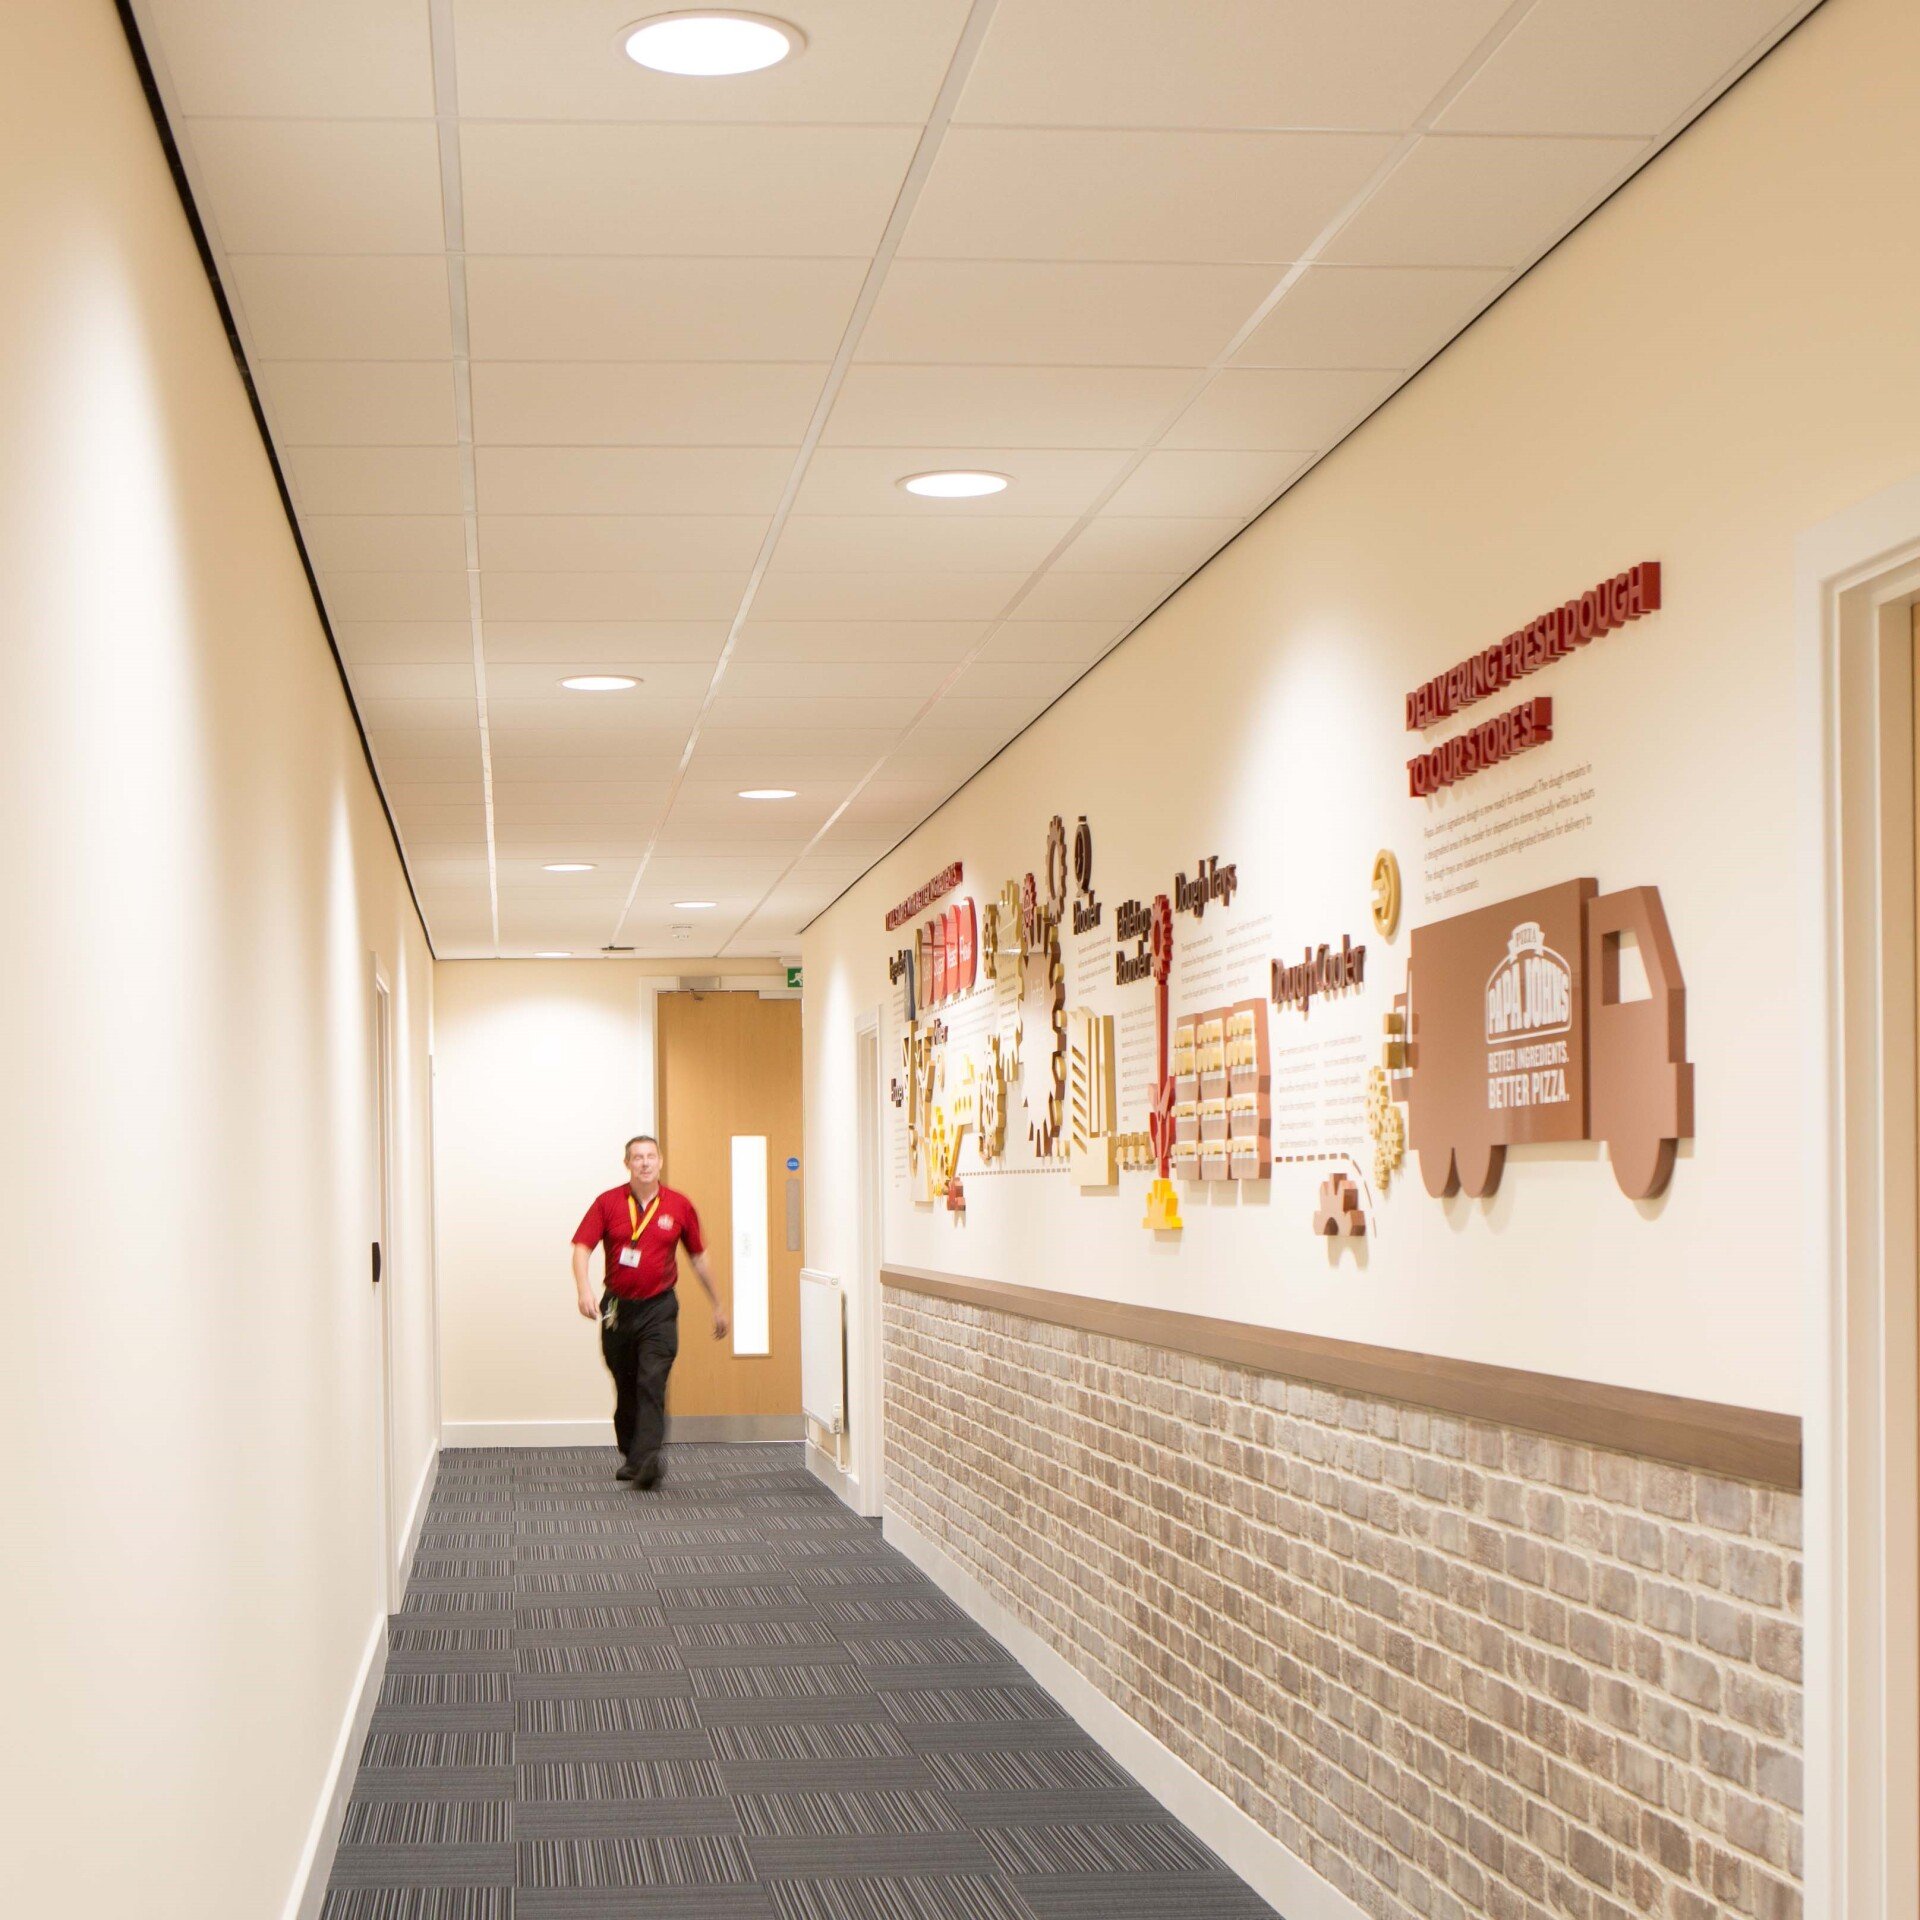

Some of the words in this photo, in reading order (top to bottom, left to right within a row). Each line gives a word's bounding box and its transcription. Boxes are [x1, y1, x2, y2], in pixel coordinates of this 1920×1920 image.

[1406, 645, 1502, 731] DELIVERING
[1501, 606, 1566, 687] FRESH
[1564, 562, 1661, 652] DOUGH
[1406, 754, 1431, 797] TO
[1428, 735, 1467, 793] OUR
[1175, 860, 1209, 918] Dough
[1207, 855, 1237, 906] Trays
[1116, 940, 1152, 985] Rounder
[1272, 947, 1317, 1012] Dough
[1315, 934, 1366, 992] Cooler
[1488, 961, 1523, 1034] PAPA
[1488, 1049, 1516, 1074] BETTER
[1517, 1040, 1569, 1069] INGREDIENTS.
[1488, 1074, 1530, 1109] BETTER
[1531, 1069, 1569, 1105] PIZZA.
